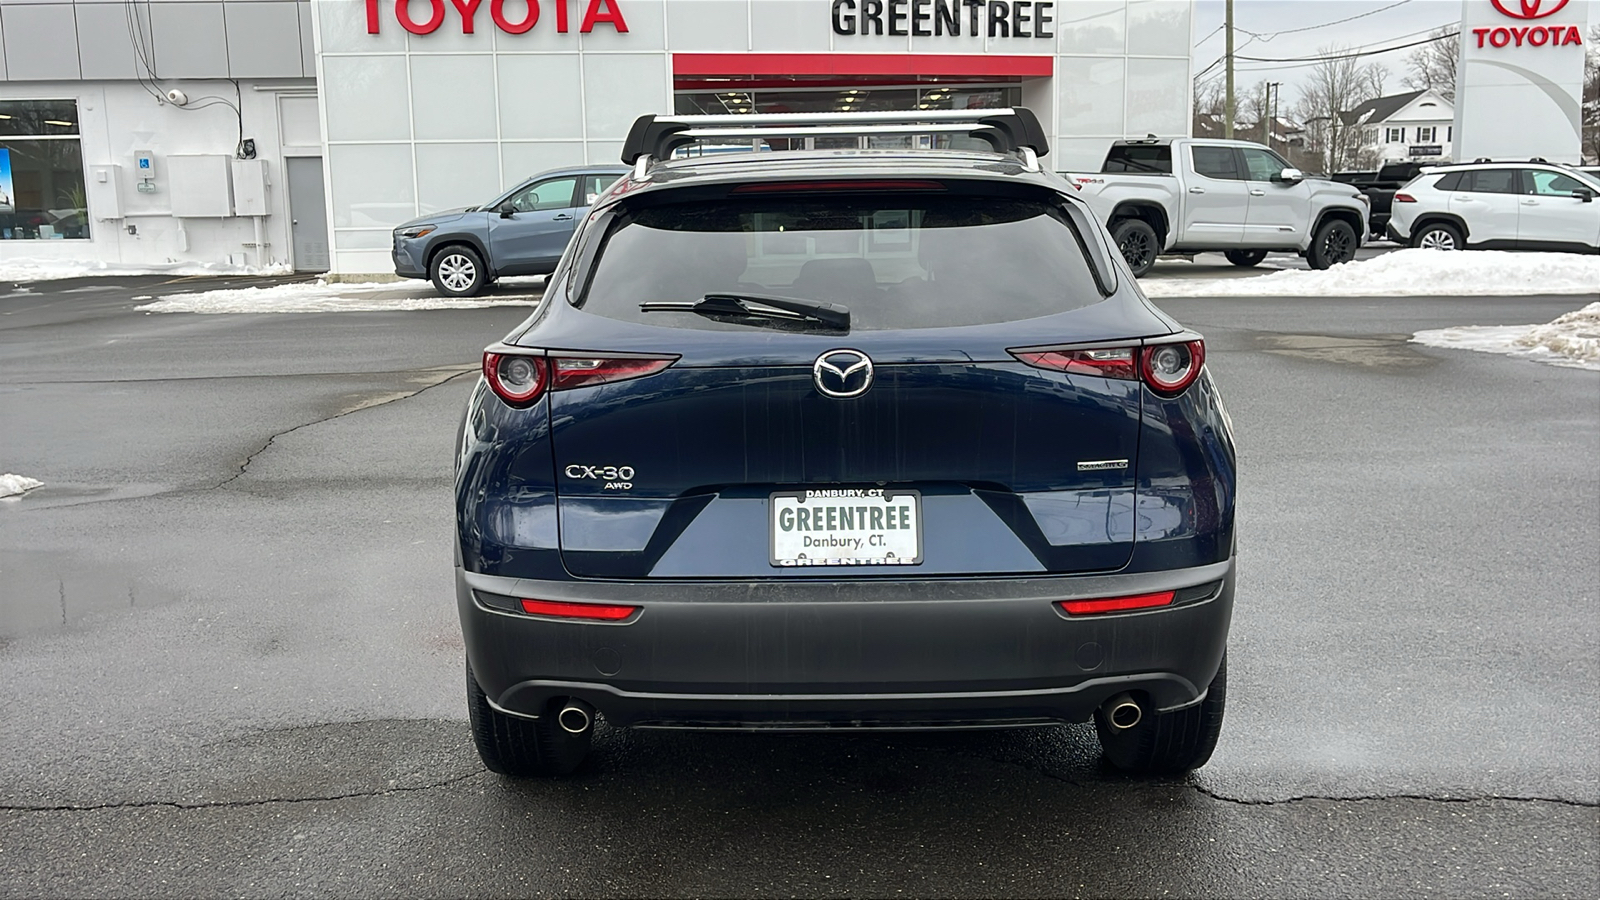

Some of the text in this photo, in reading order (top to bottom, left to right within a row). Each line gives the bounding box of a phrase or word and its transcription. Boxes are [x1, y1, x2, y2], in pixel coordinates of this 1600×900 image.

[832, 0, 1054, 38] GREENTREE
[1473, 26, 1582, 48] TOYOTA
[565, 464, 635, 480] CX-30
[604, 482, 633, 490] AWD
[806, 489, 884, 498] DANBURY, CT
[779, 506, 911, 532] GREENTREE
[803, 534, 887, 550] Danbury, CT.
[780, 558, 914, 566] GREENTREE
